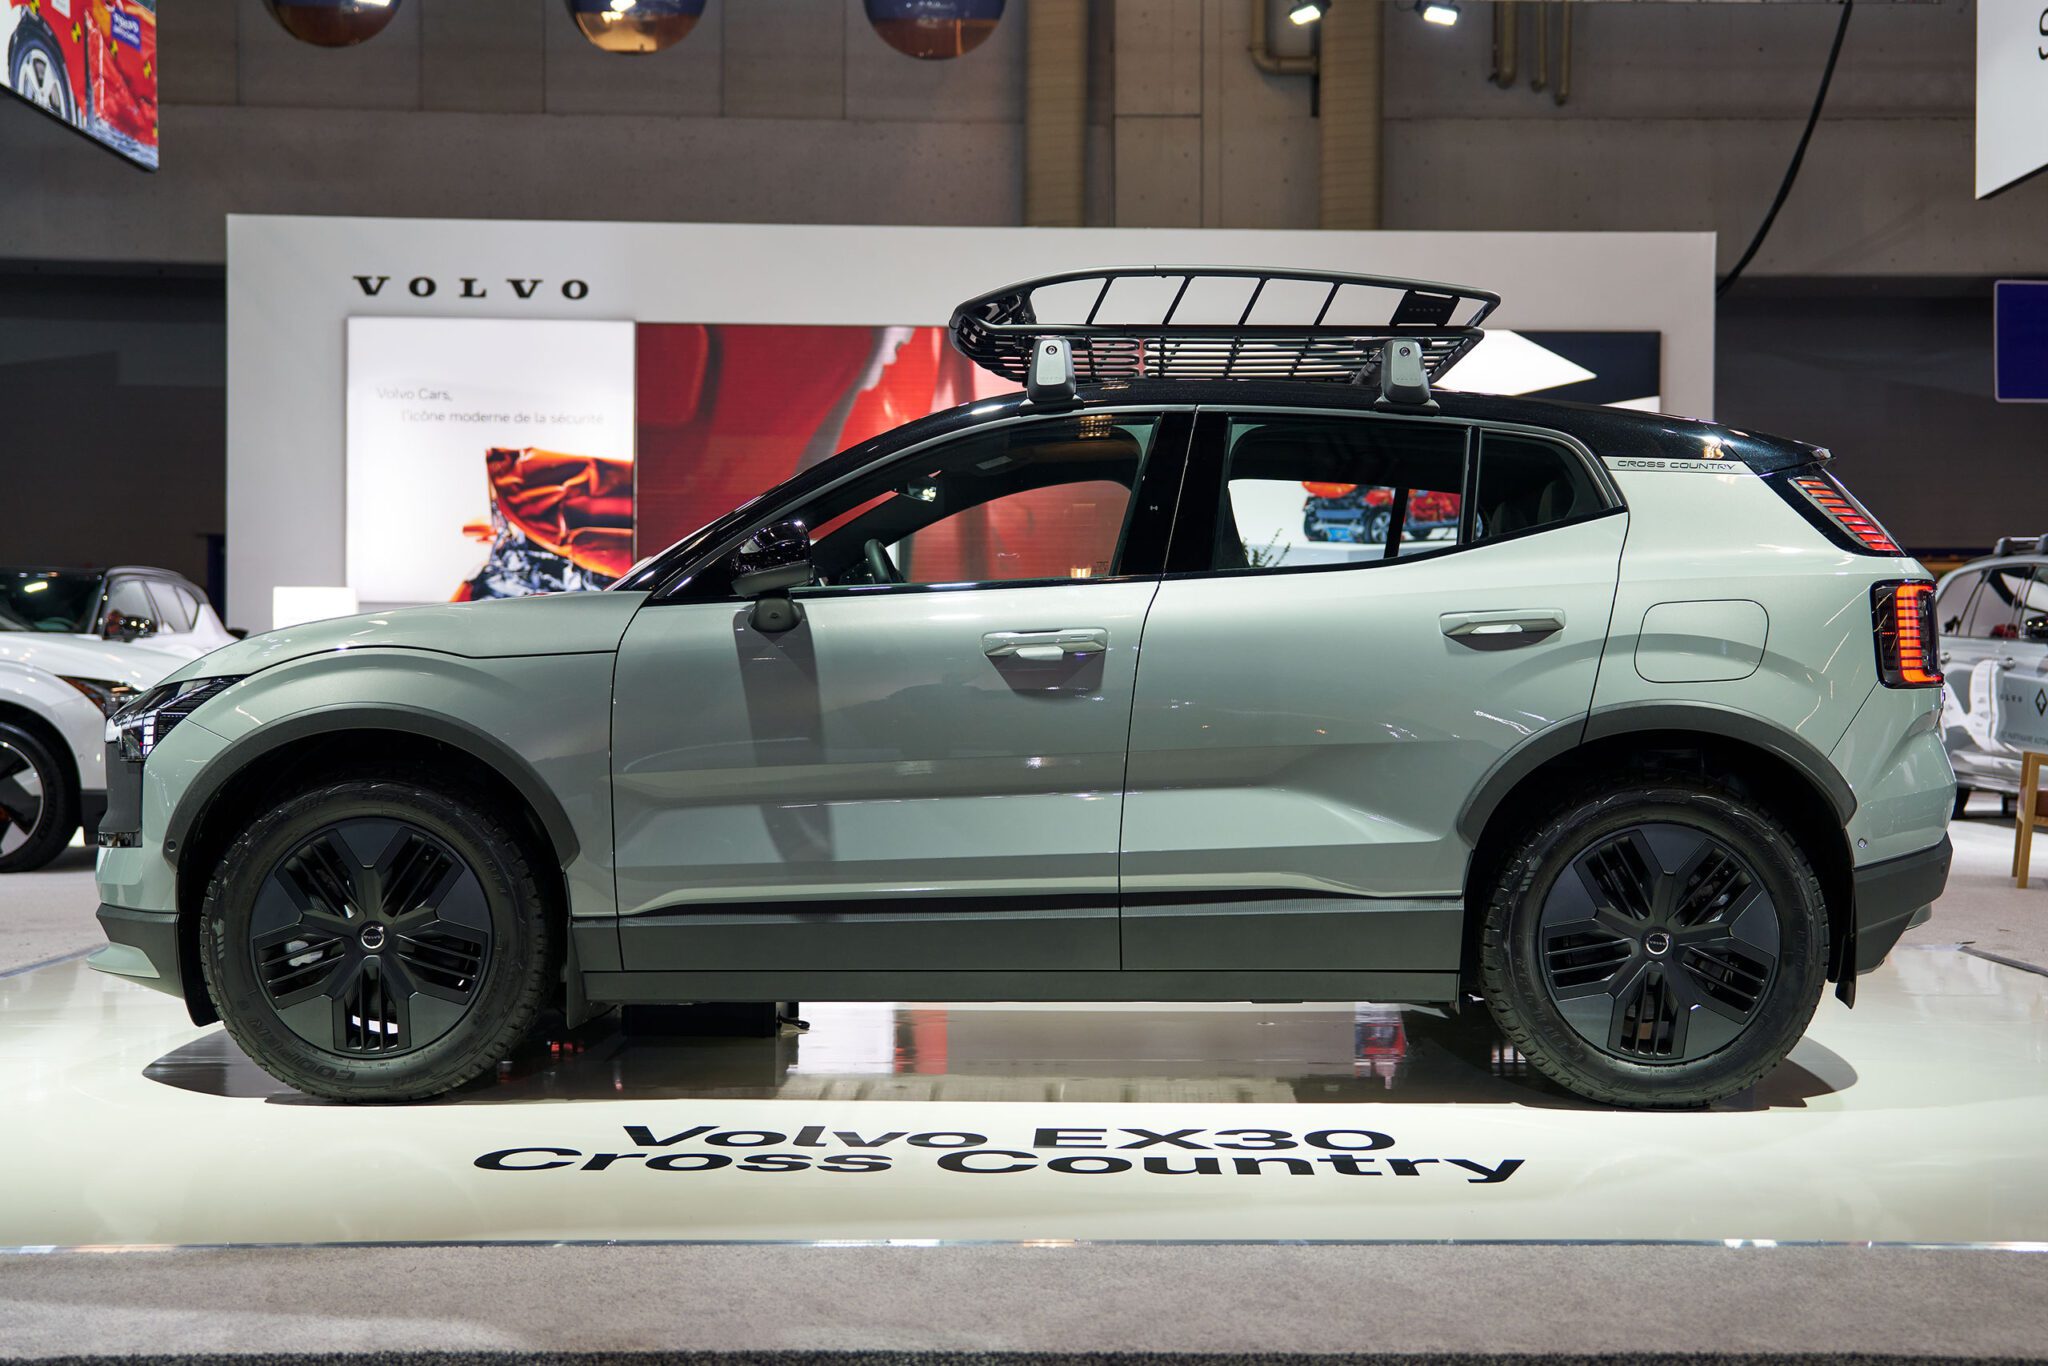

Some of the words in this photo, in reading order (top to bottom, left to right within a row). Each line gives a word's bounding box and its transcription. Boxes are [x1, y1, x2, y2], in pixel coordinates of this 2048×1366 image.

[352, 275, 589, 300] VOLVO
[376, 386, 415, 399] Volvo
[418, 387, 453, 401] Cars,
[449, 410, 511, 424] moderne
[514, 411, 531, 424] de
[534, 411, 547, 424] la
[1617, 460, 1666, 468] CROSS
[1669, 461, 1736, 470] COUNTRY
[623, 1125, 988, 1148] Volvo
[1033, 1128, 1396, 1151] EX30
[473, 1147, 893, 1173] Cross
[937, 1149, 1526, 1184] Country
